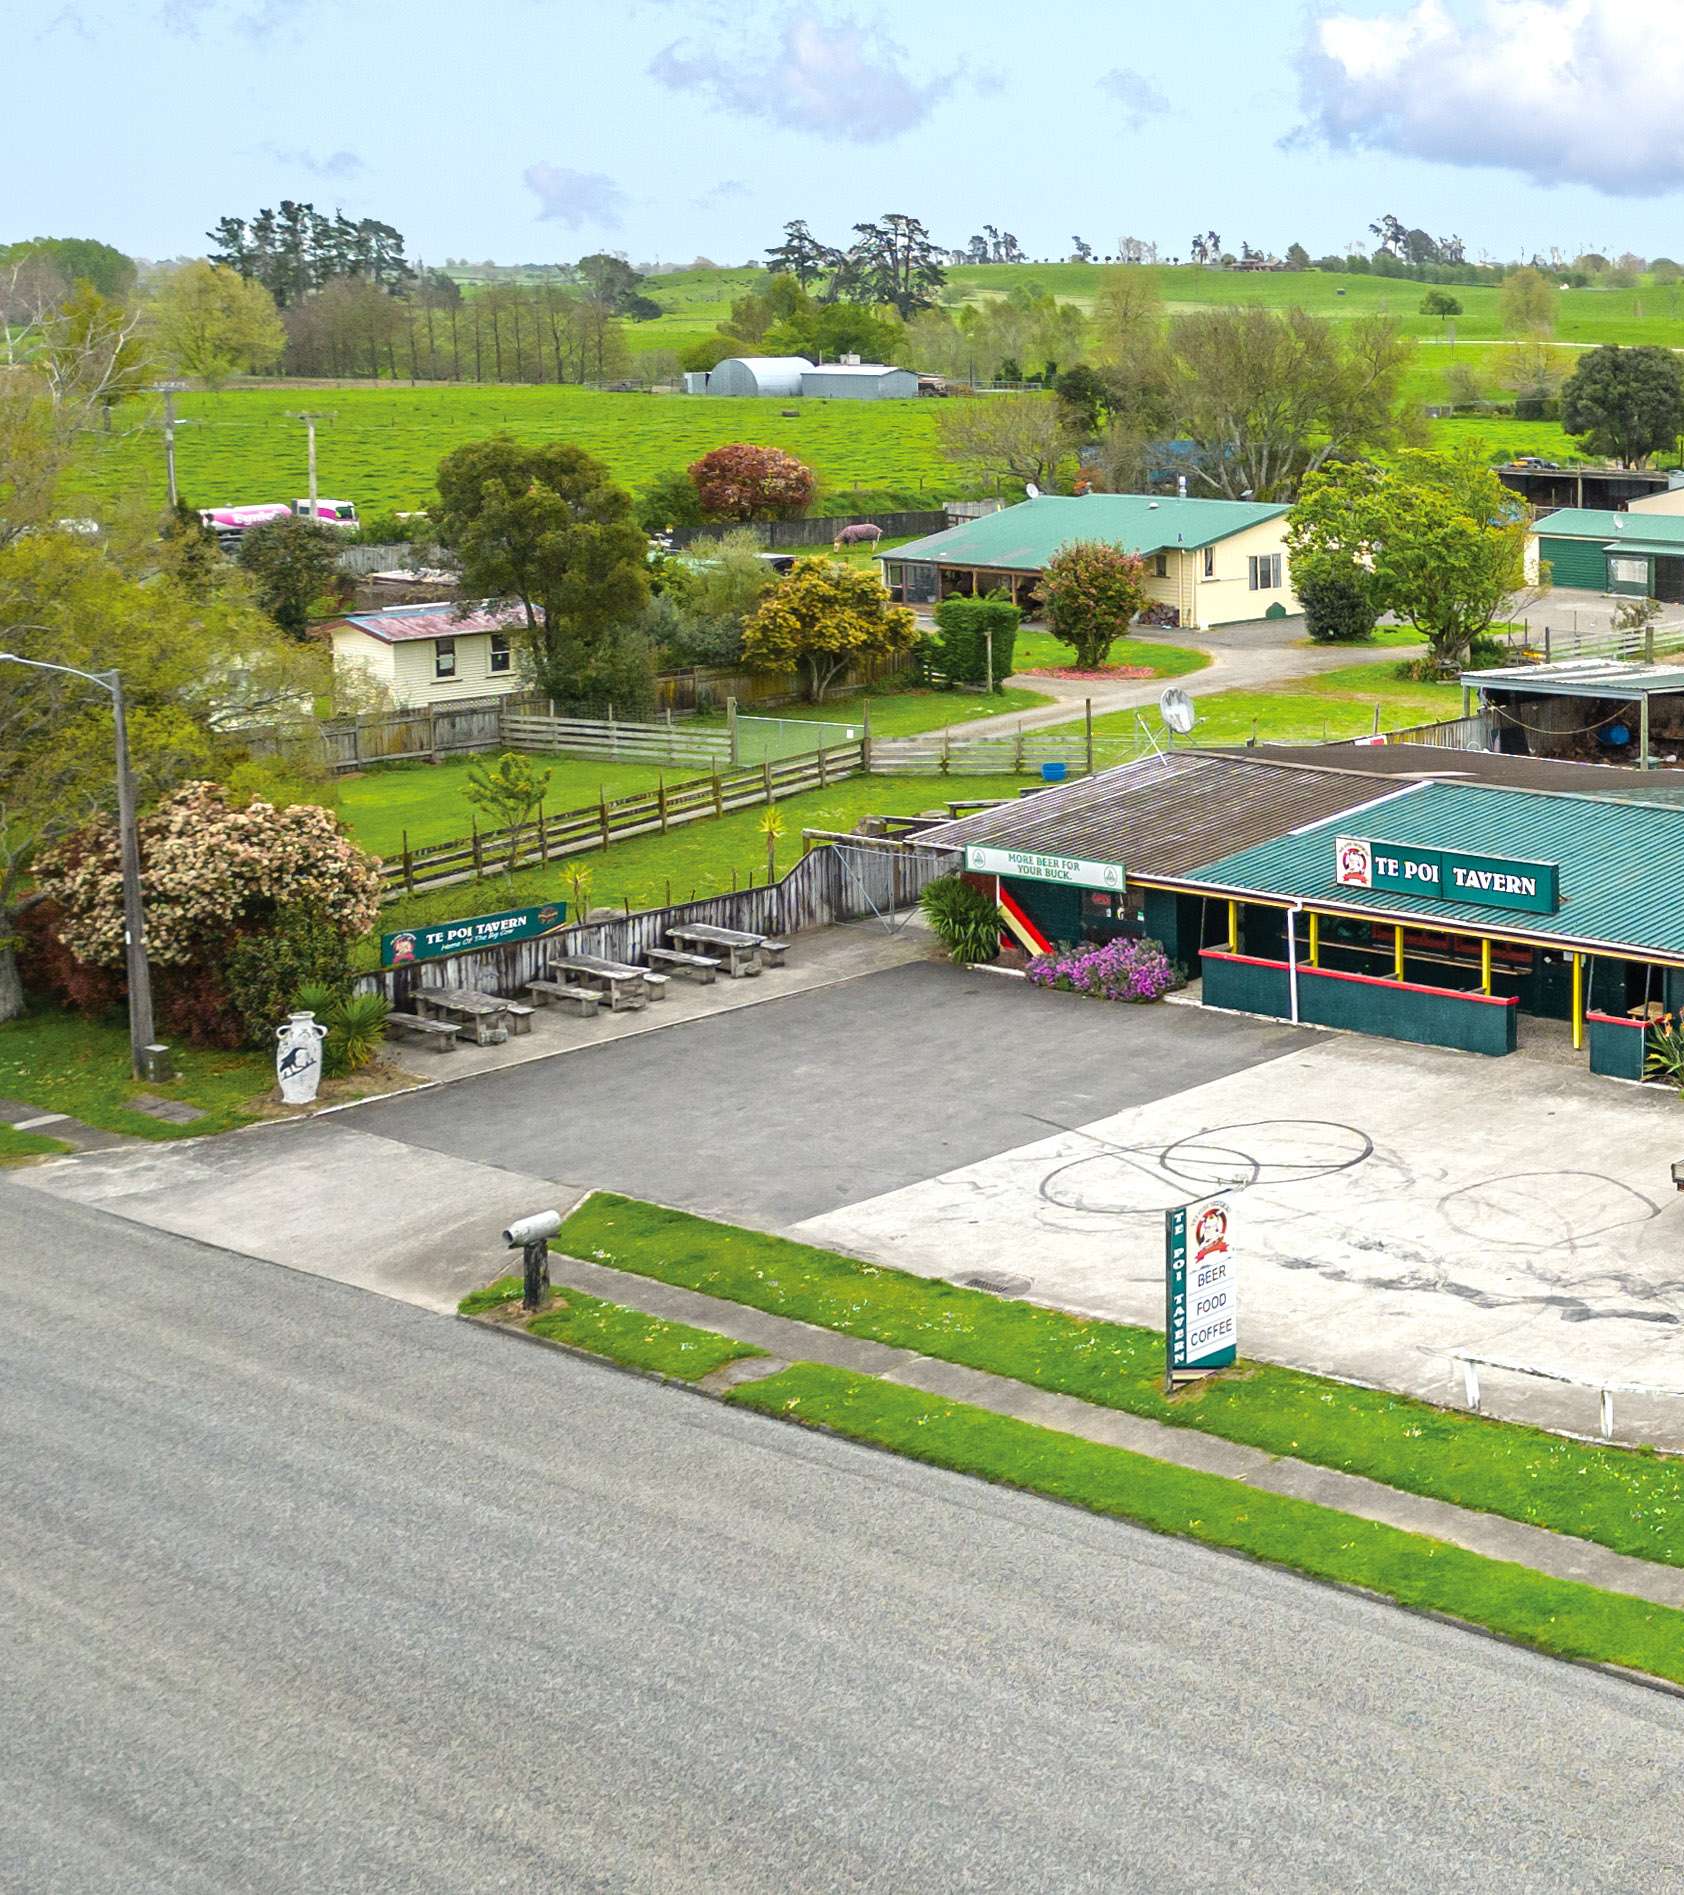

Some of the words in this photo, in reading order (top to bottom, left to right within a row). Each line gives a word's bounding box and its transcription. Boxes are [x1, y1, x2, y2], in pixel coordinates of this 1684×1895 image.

[1008, 853, 1034, 865] MORE
[1036, 858, 1060, 870] BEER
[1062, 861, 1081, 872] FOR
[1017, 865, 1042, 876] YOUR
[1044, 868, 1073, 880] BUCK.
[1375, 857, 1399, 876] TE
[1404, 861, 1440, 883] POI
[1452, 867, 1537, 896] TAVERN
[426, 933, 443, 945] TE
[447, 926, 472, 941] POI
[476, 916, 528, 935] TAVERN
[1173, 1212, 1185, 1235] TE
[1173, 1248, 1185, 1281] POI
[1198, 1264, 1226, 1287] BEER
[1197, 1293, 1227, 1316] FOOD
[1173, 1293, 1185, 1364] TAVERN
[1190, 1318, 1232, 1346] COFFEE
